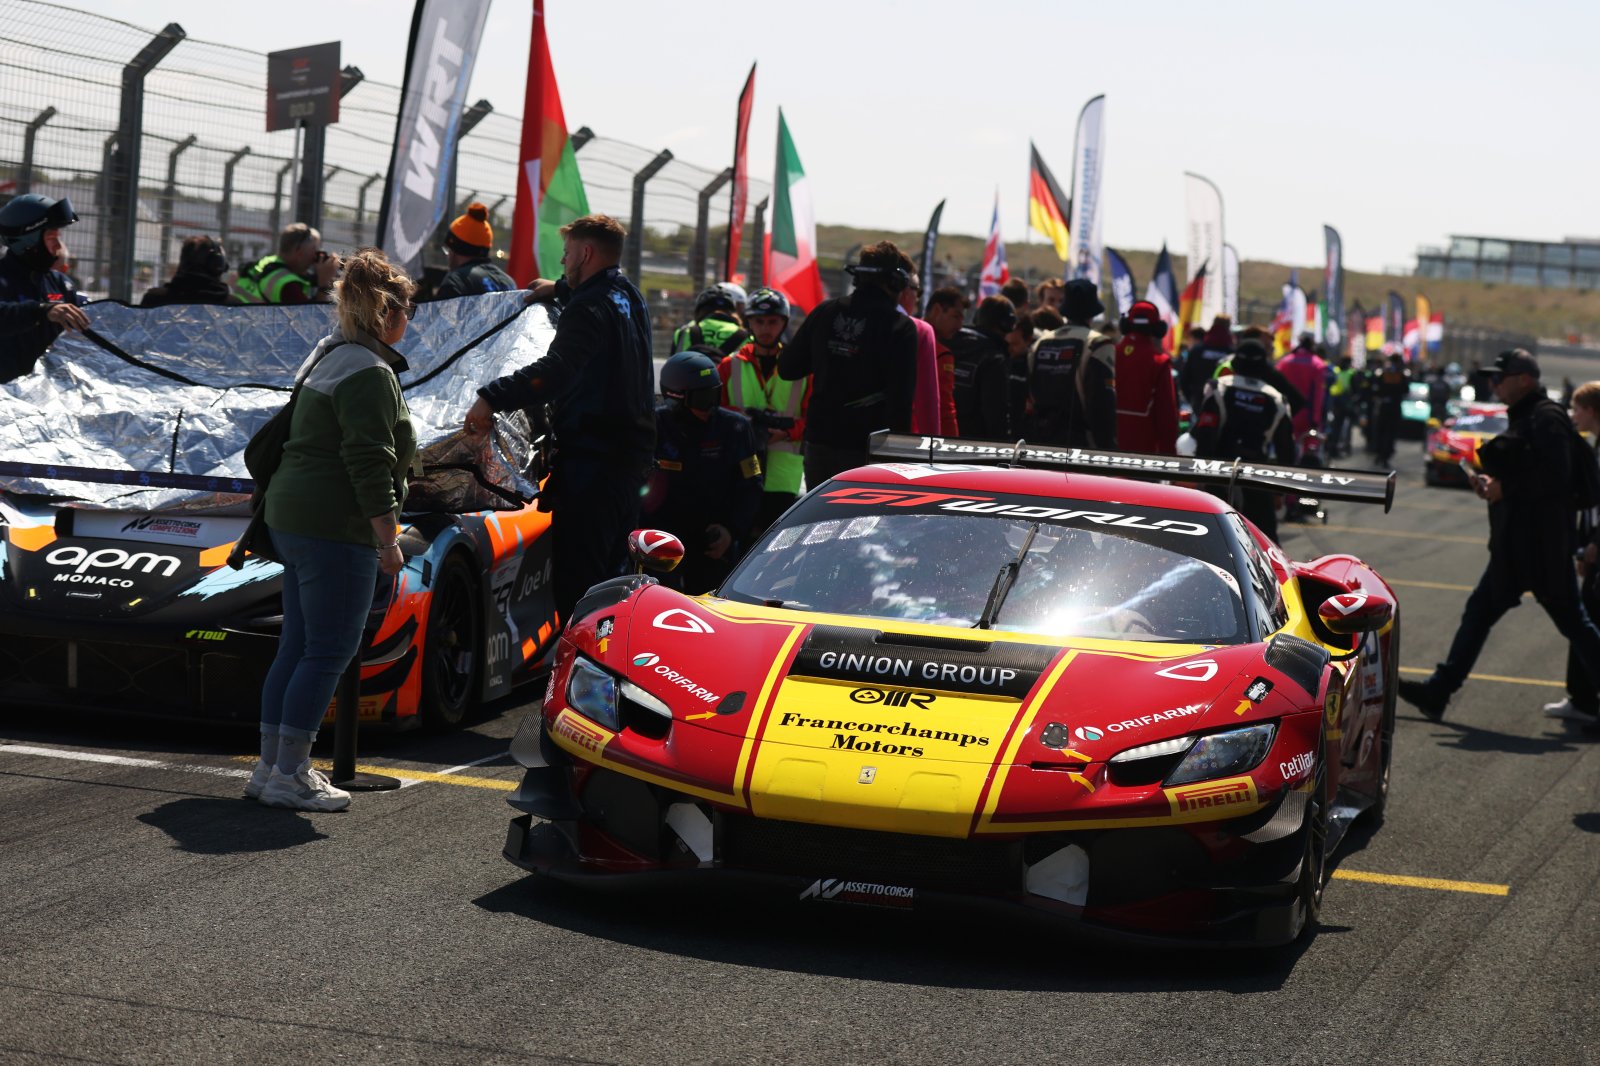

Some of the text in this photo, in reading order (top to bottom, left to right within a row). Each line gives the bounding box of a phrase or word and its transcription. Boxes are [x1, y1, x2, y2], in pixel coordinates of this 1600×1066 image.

[404, 17, 465, 201] WRT
[916, 437, 1180, 469] Francorchamps
[819, 487, 1209, 536] GT WORLD
[45, 546, 182, 577] apm
[53, 573, 134, 588] MONACO
[517, 569, 542, 602] Joe
[197, 630, 227, 641] TOW
[654, 665, 720, 704] ORIFARM
[819, 651, 1017, 687] GINION GROUP
[554, 713, 604, 753] PIRELLI
[778, 712, 990, 748] Francorchamps
[1107, 704, 1200, 732] ORIFARM
[829, 734, 924, 757] Motors
[1279, 750, 1315, 780] Cetilar
[1175, 782, 1250, 812] PIRELLI
[844, 881, 914, 898] ASSETTO CORSA
